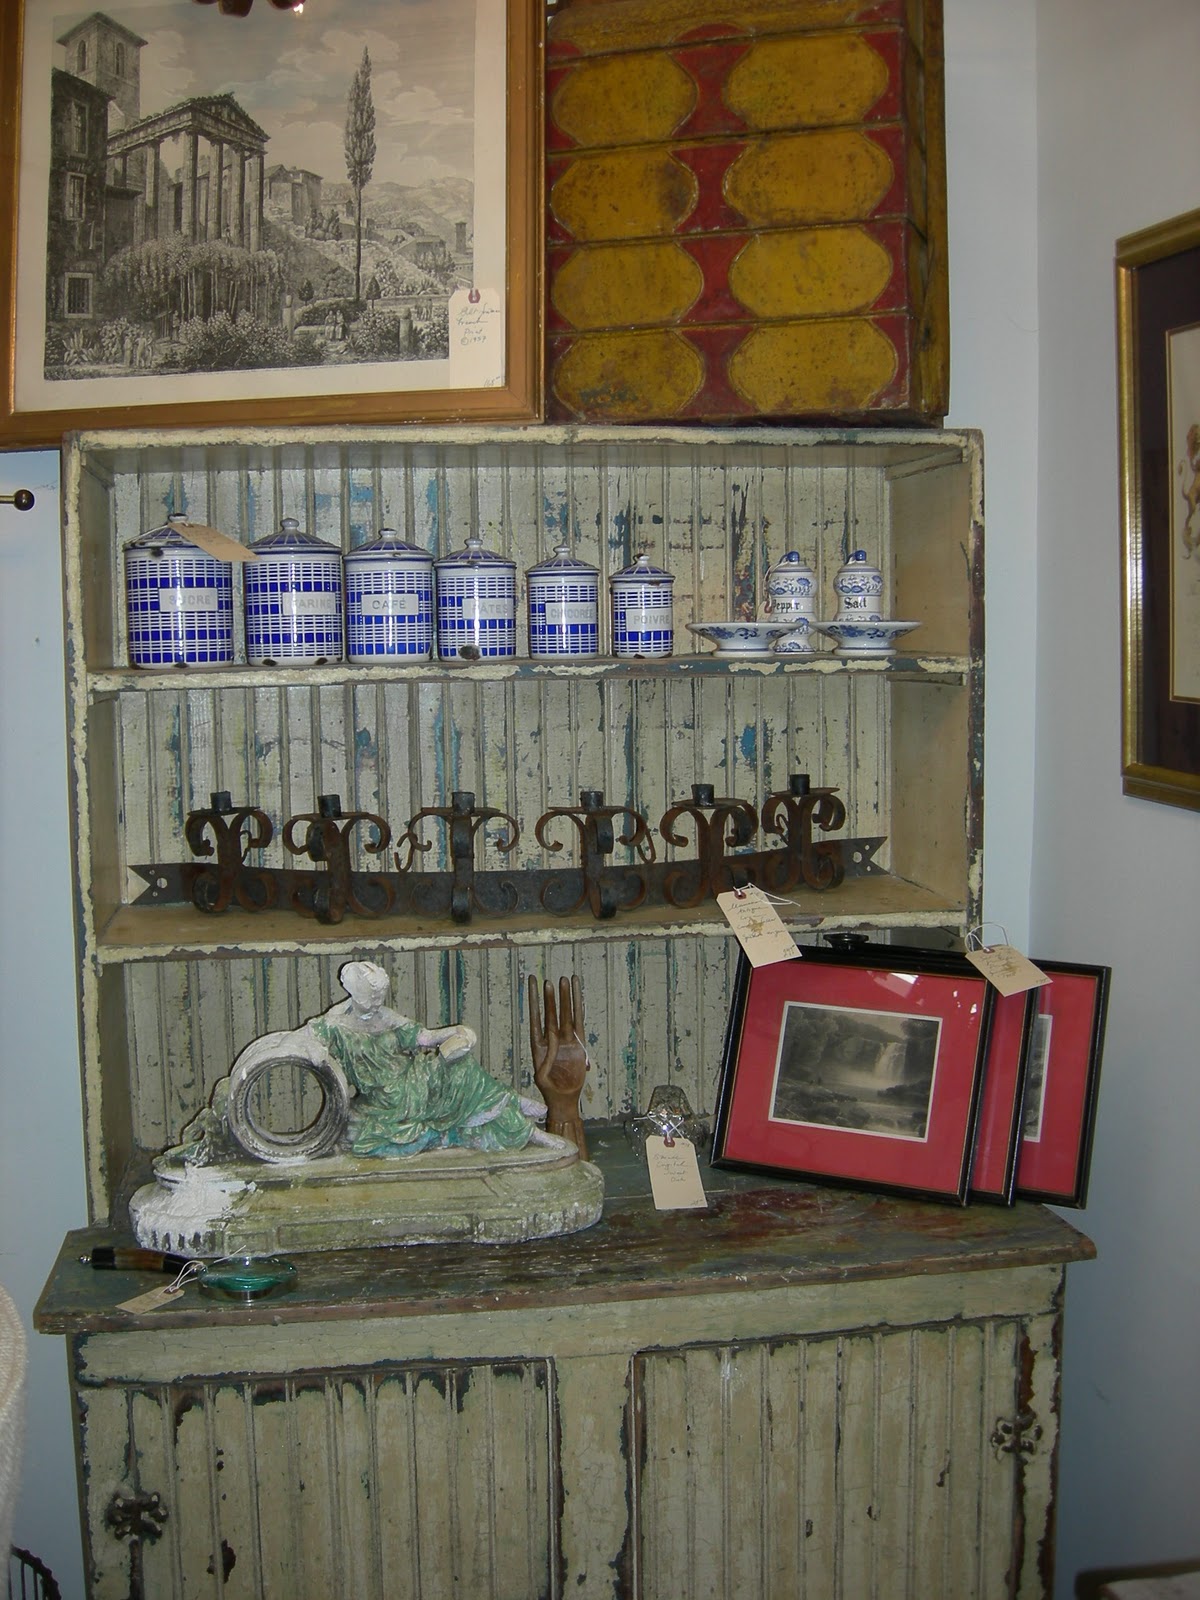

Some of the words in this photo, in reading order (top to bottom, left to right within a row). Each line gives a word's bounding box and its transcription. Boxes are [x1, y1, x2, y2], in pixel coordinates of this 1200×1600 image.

[292, 598, 332, 609] ARINE
[371, 597, 407, 610] CAFÉ
[844, 597, 867, 610] Salt
[633, 614, 671, 625] POIVRE
